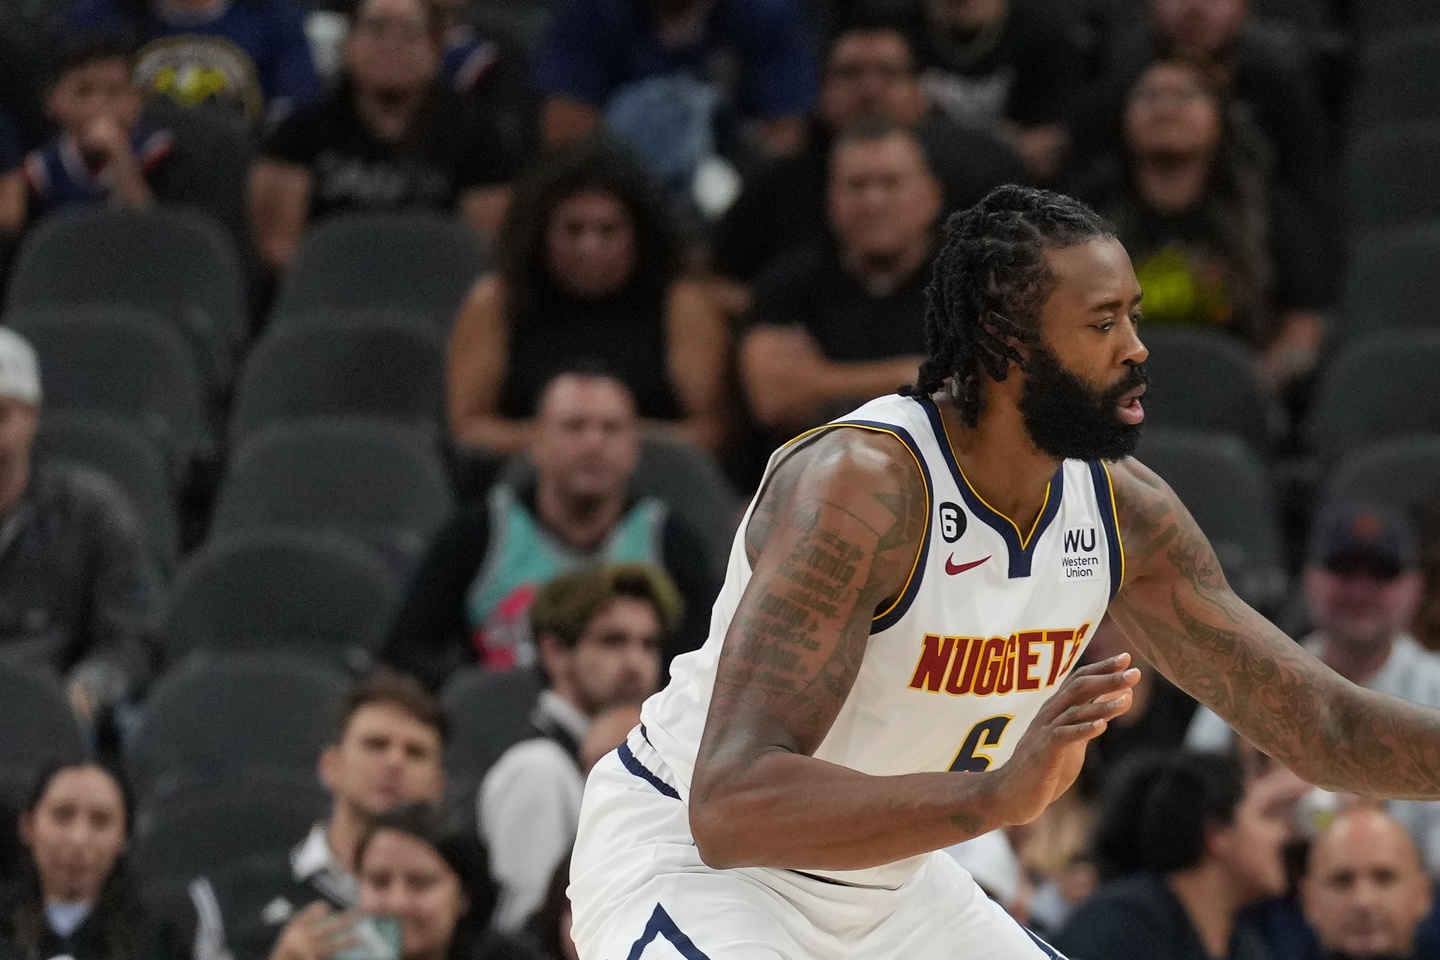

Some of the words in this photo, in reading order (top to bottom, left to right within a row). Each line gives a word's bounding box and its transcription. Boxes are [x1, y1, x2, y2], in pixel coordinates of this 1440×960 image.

[941, 508, 958, 539] 6
[1063, 528, 1096, 553] WU
[1061, 556, 1099, 567] Western
[1065, 567, 1093, 578] Union
